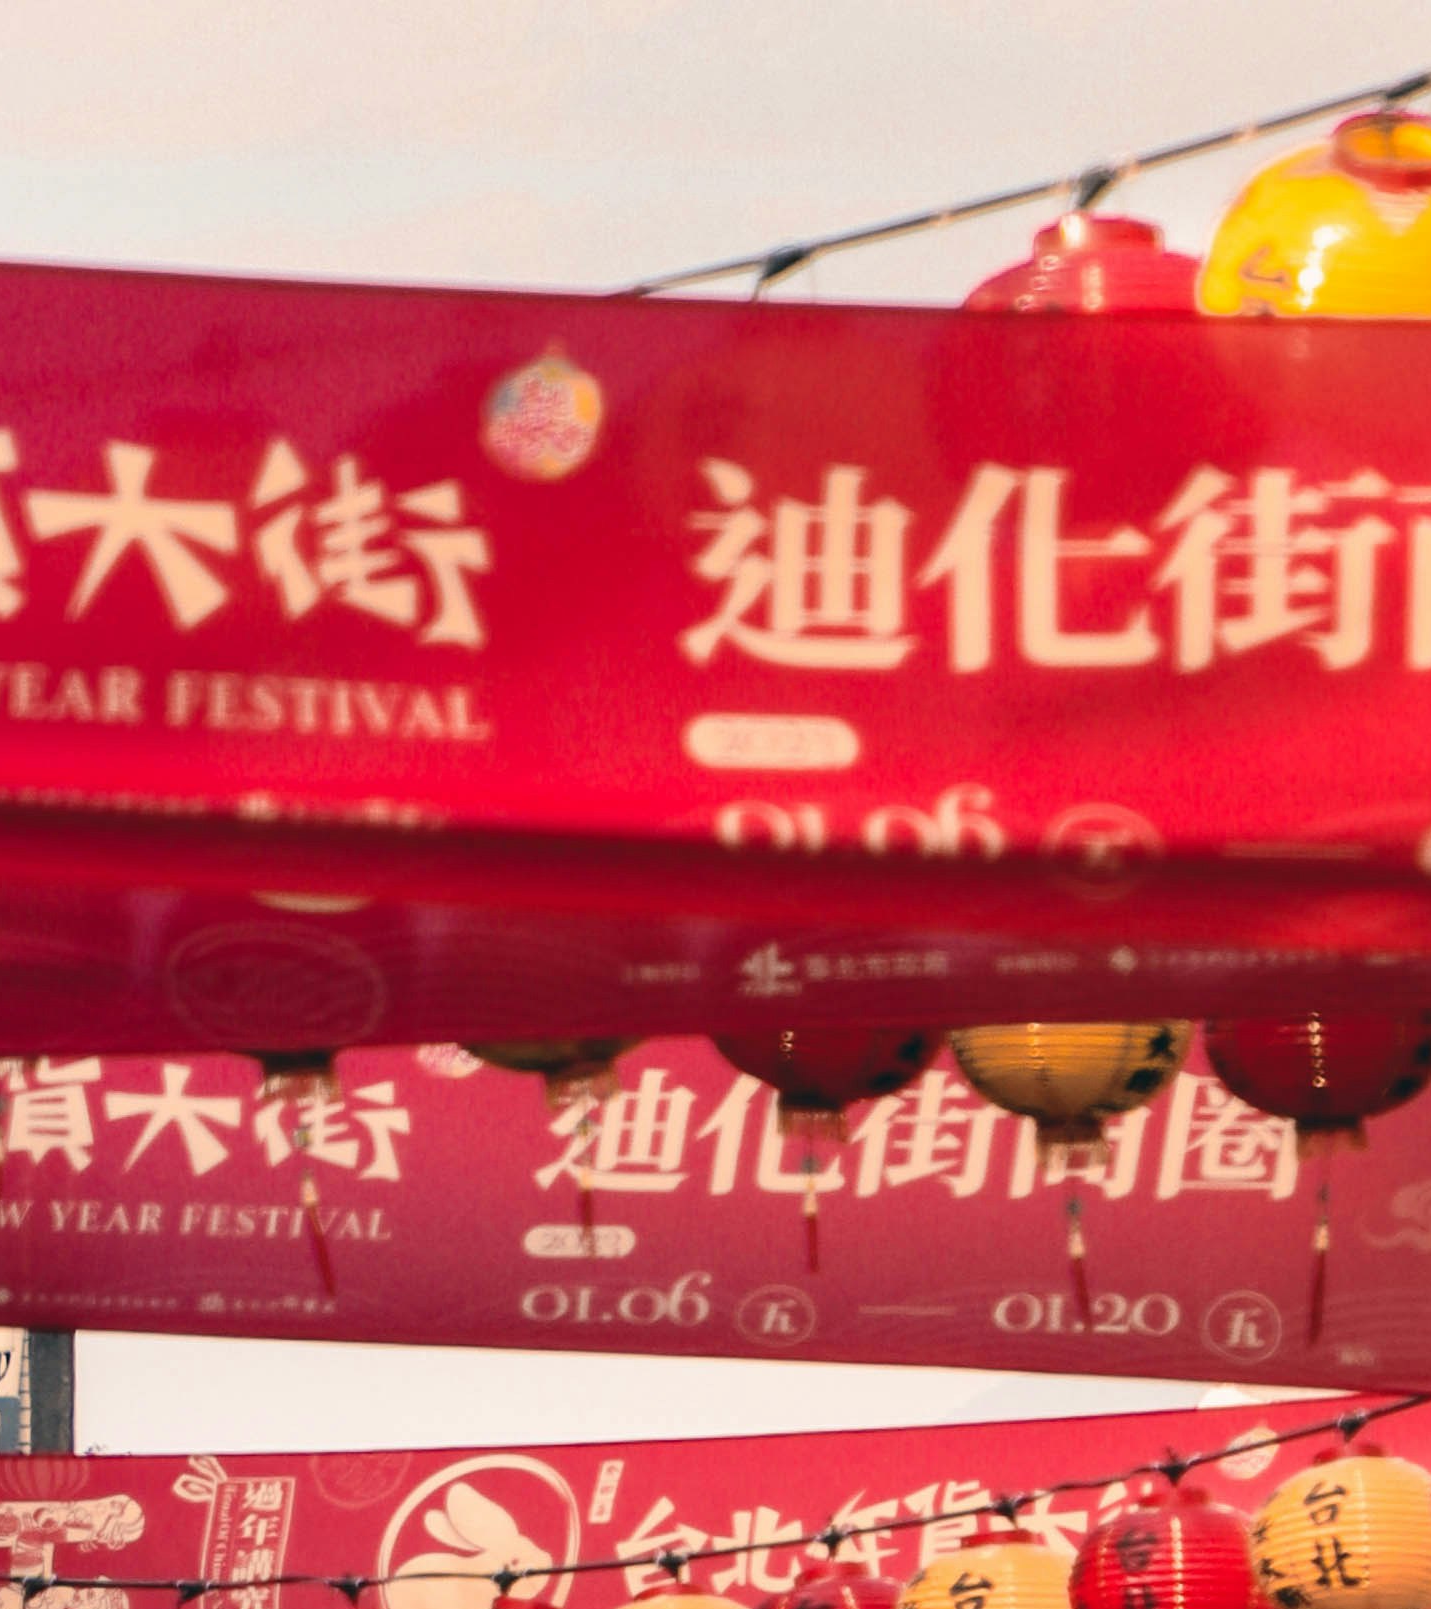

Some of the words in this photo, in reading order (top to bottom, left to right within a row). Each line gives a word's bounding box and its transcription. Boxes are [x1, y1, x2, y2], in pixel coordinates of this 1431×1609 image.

[167, 669, 492, 742] FESTIVAL
[50, 1201, 163, 1235] YEAR
[179, 1204, 392, 1241] FESTIVAL
[521, 1272, 713, 1325] 01.06
[992, 1293, 1181, 1335] 01.20
